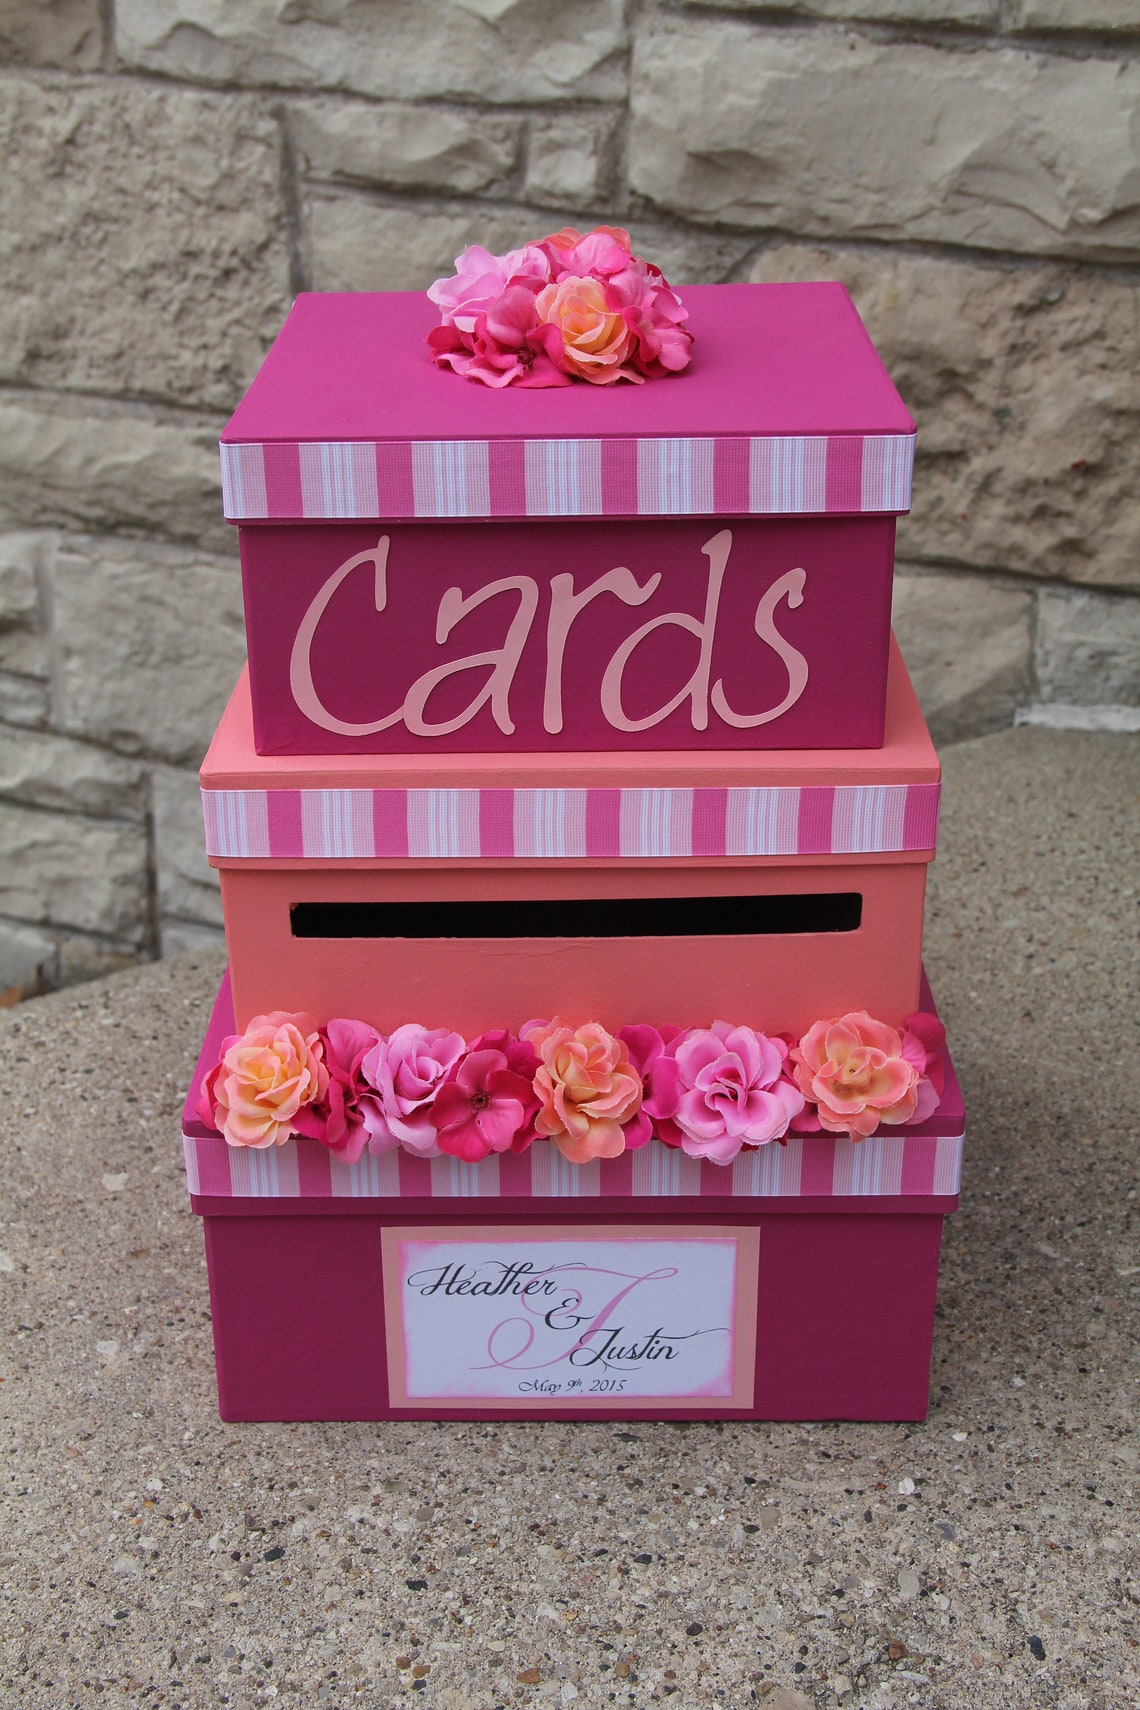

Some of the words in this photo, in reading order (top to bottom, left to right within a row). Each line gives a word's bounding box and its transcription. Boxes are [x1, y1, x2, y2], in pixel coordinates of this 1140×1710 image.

[289, 529, 809, 737] Cards
[407, 1261, 587, 1297] Heather
[544, 1297, 595, 1330] &
[569, 1327, 731, 1372] Justin
[518, 1379, 561, 1395] May
[565, 1378, 583, 1393] 9th,
[588, 1379, 627, 1392] 2015
